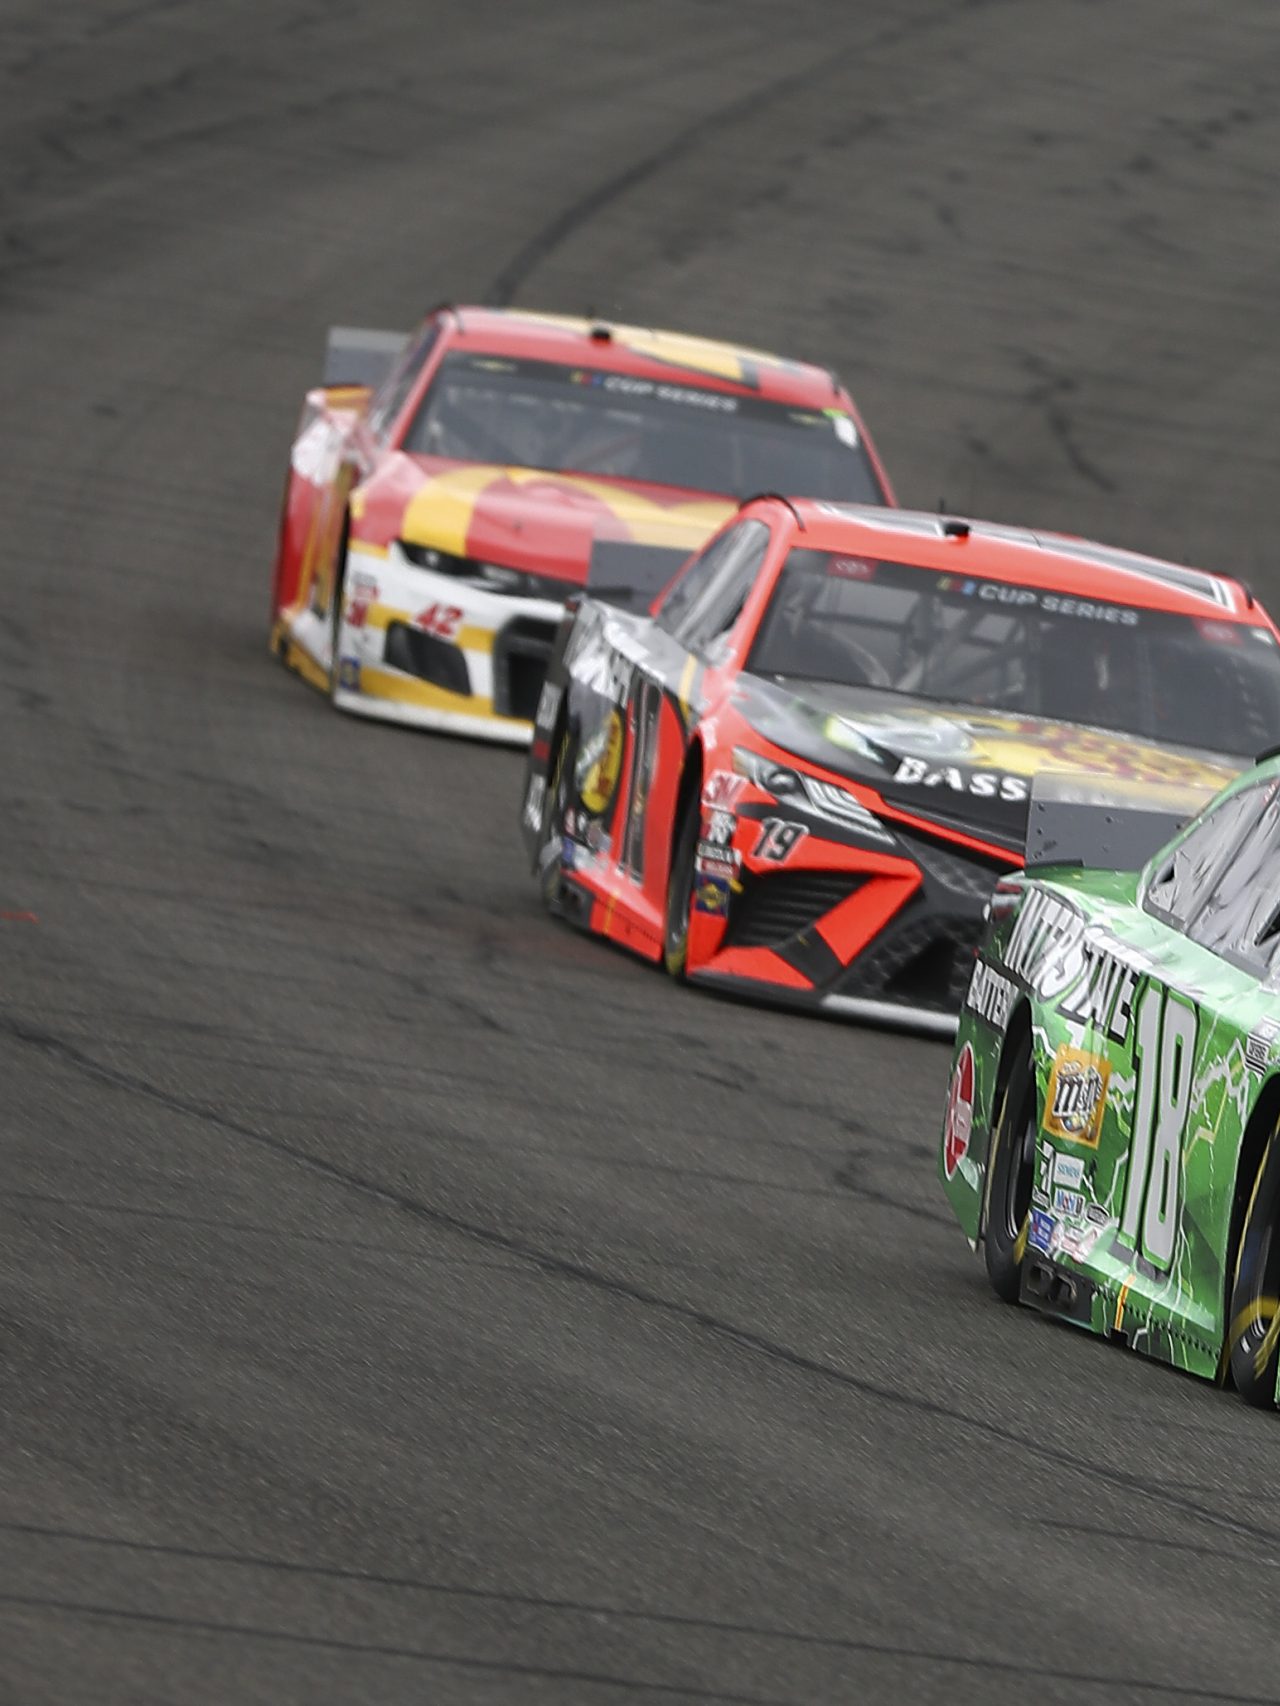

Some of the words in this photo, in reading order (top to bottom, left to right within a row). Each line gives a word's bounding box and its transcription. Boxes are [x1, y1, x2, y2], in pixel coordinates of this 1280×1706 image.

[416, 602, 464, 636] 42
[978, 583, 1037, 605] CUP
[1040, 597, 1140, 626] SERIES
[893, 756, 1028, 801] BASS
[753, 817, 811, 863] 19
[1118, 978, 1198, 1270] 18
